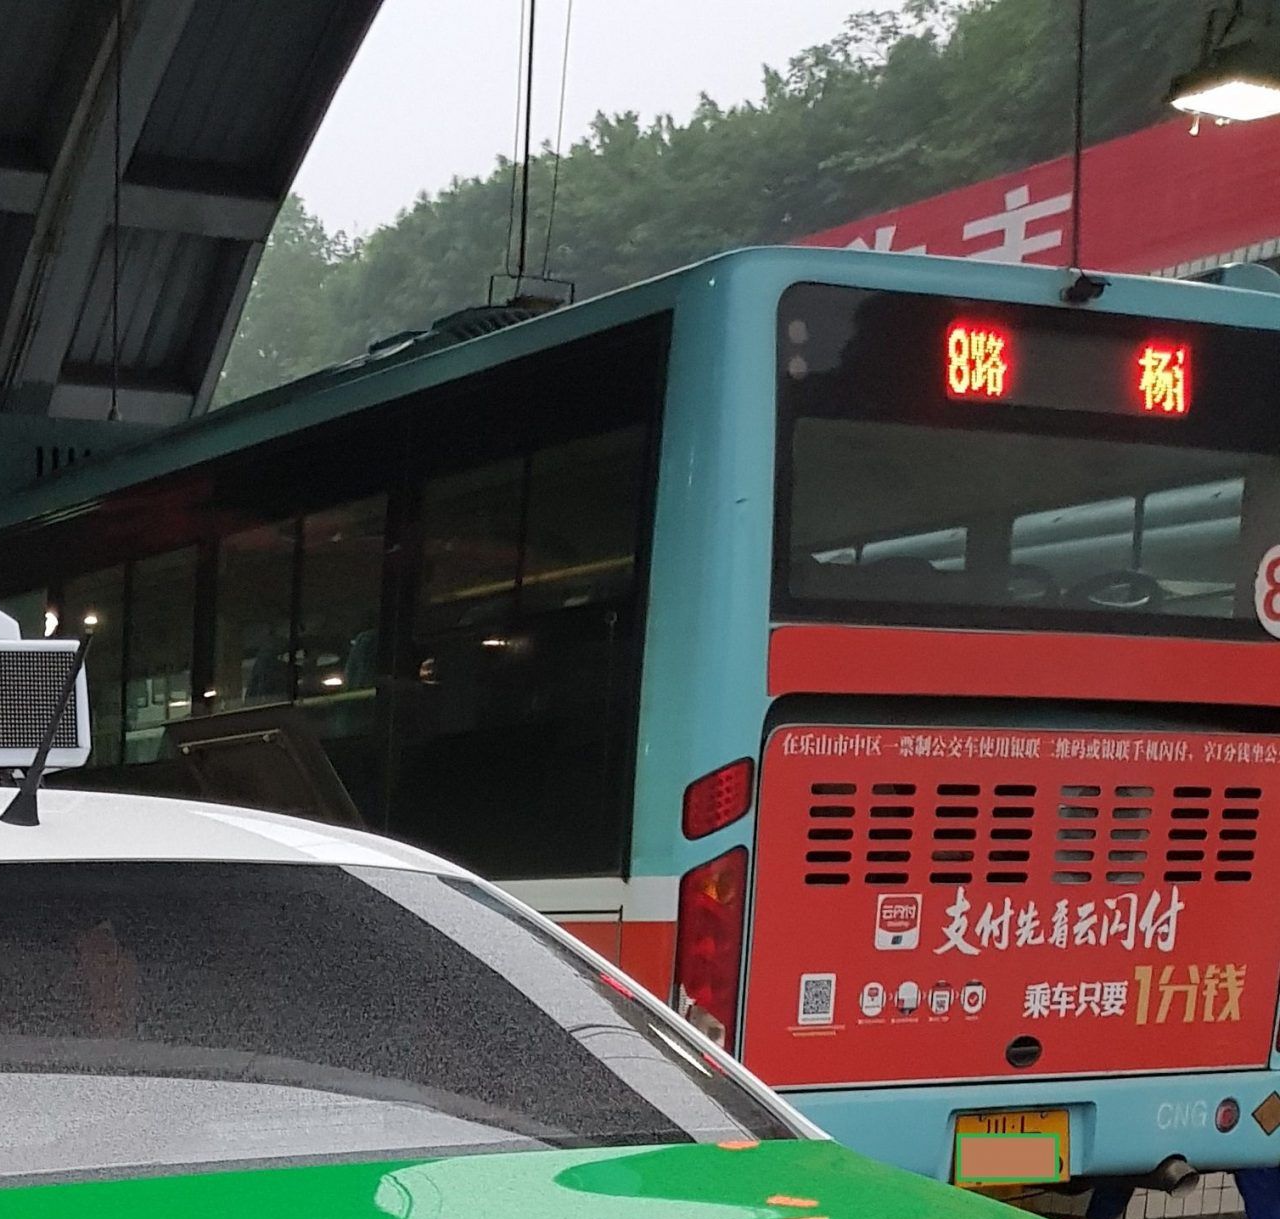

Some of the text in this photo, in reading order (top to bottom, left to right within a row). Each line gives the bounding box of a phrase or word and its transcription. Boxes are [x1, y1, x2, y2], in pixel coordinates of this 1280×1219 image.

[948, 329, 1007, 397] 8路
[932, 886, 1185, 955] 支付先看云闪付
[1157, 1100, 1208, 1130] CNG
